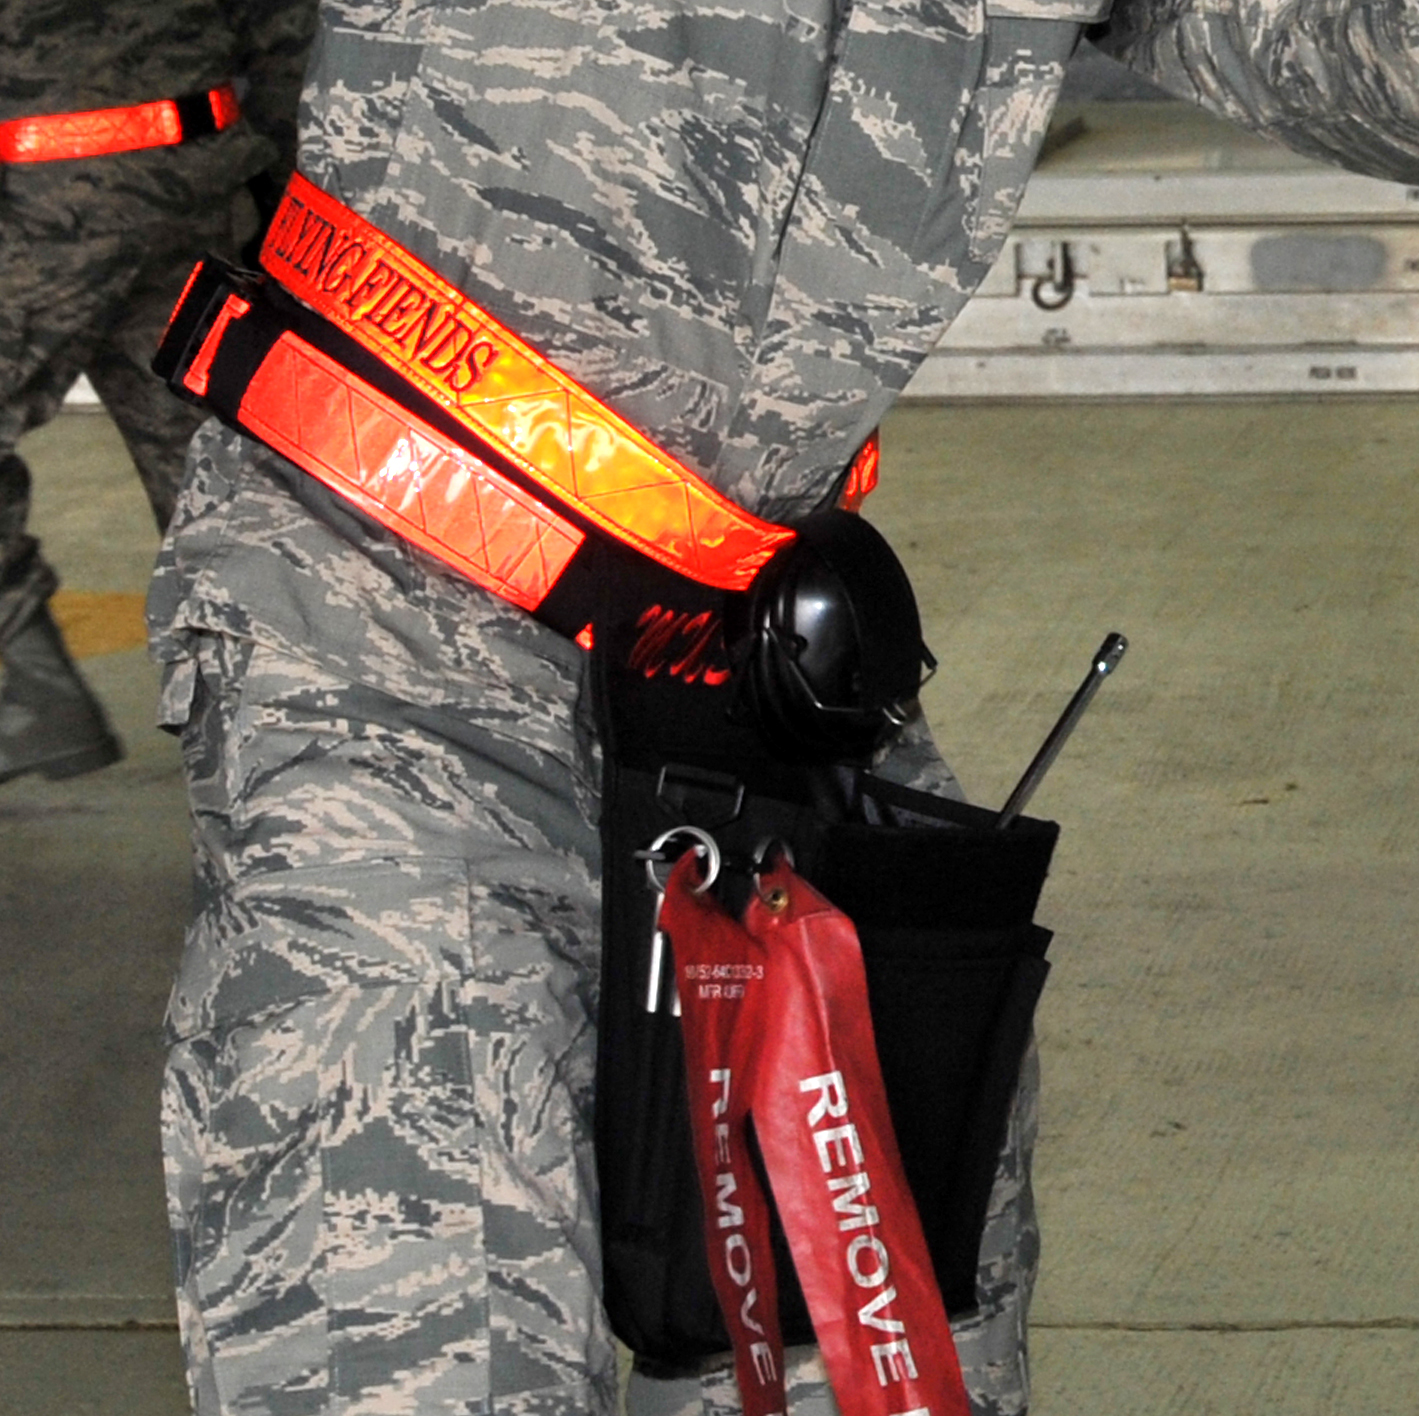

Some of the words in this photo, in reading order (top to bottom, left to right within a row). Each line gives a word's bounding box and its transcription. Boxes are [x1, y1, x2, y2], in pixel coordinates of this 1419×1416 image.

[267, 195, 367, 293] FLYING
[347, 256, 499, 393] FIENDS
[710, 1068, 778, 1386] REMOVE
[798, 1070, 919, 1388] REMOVE
